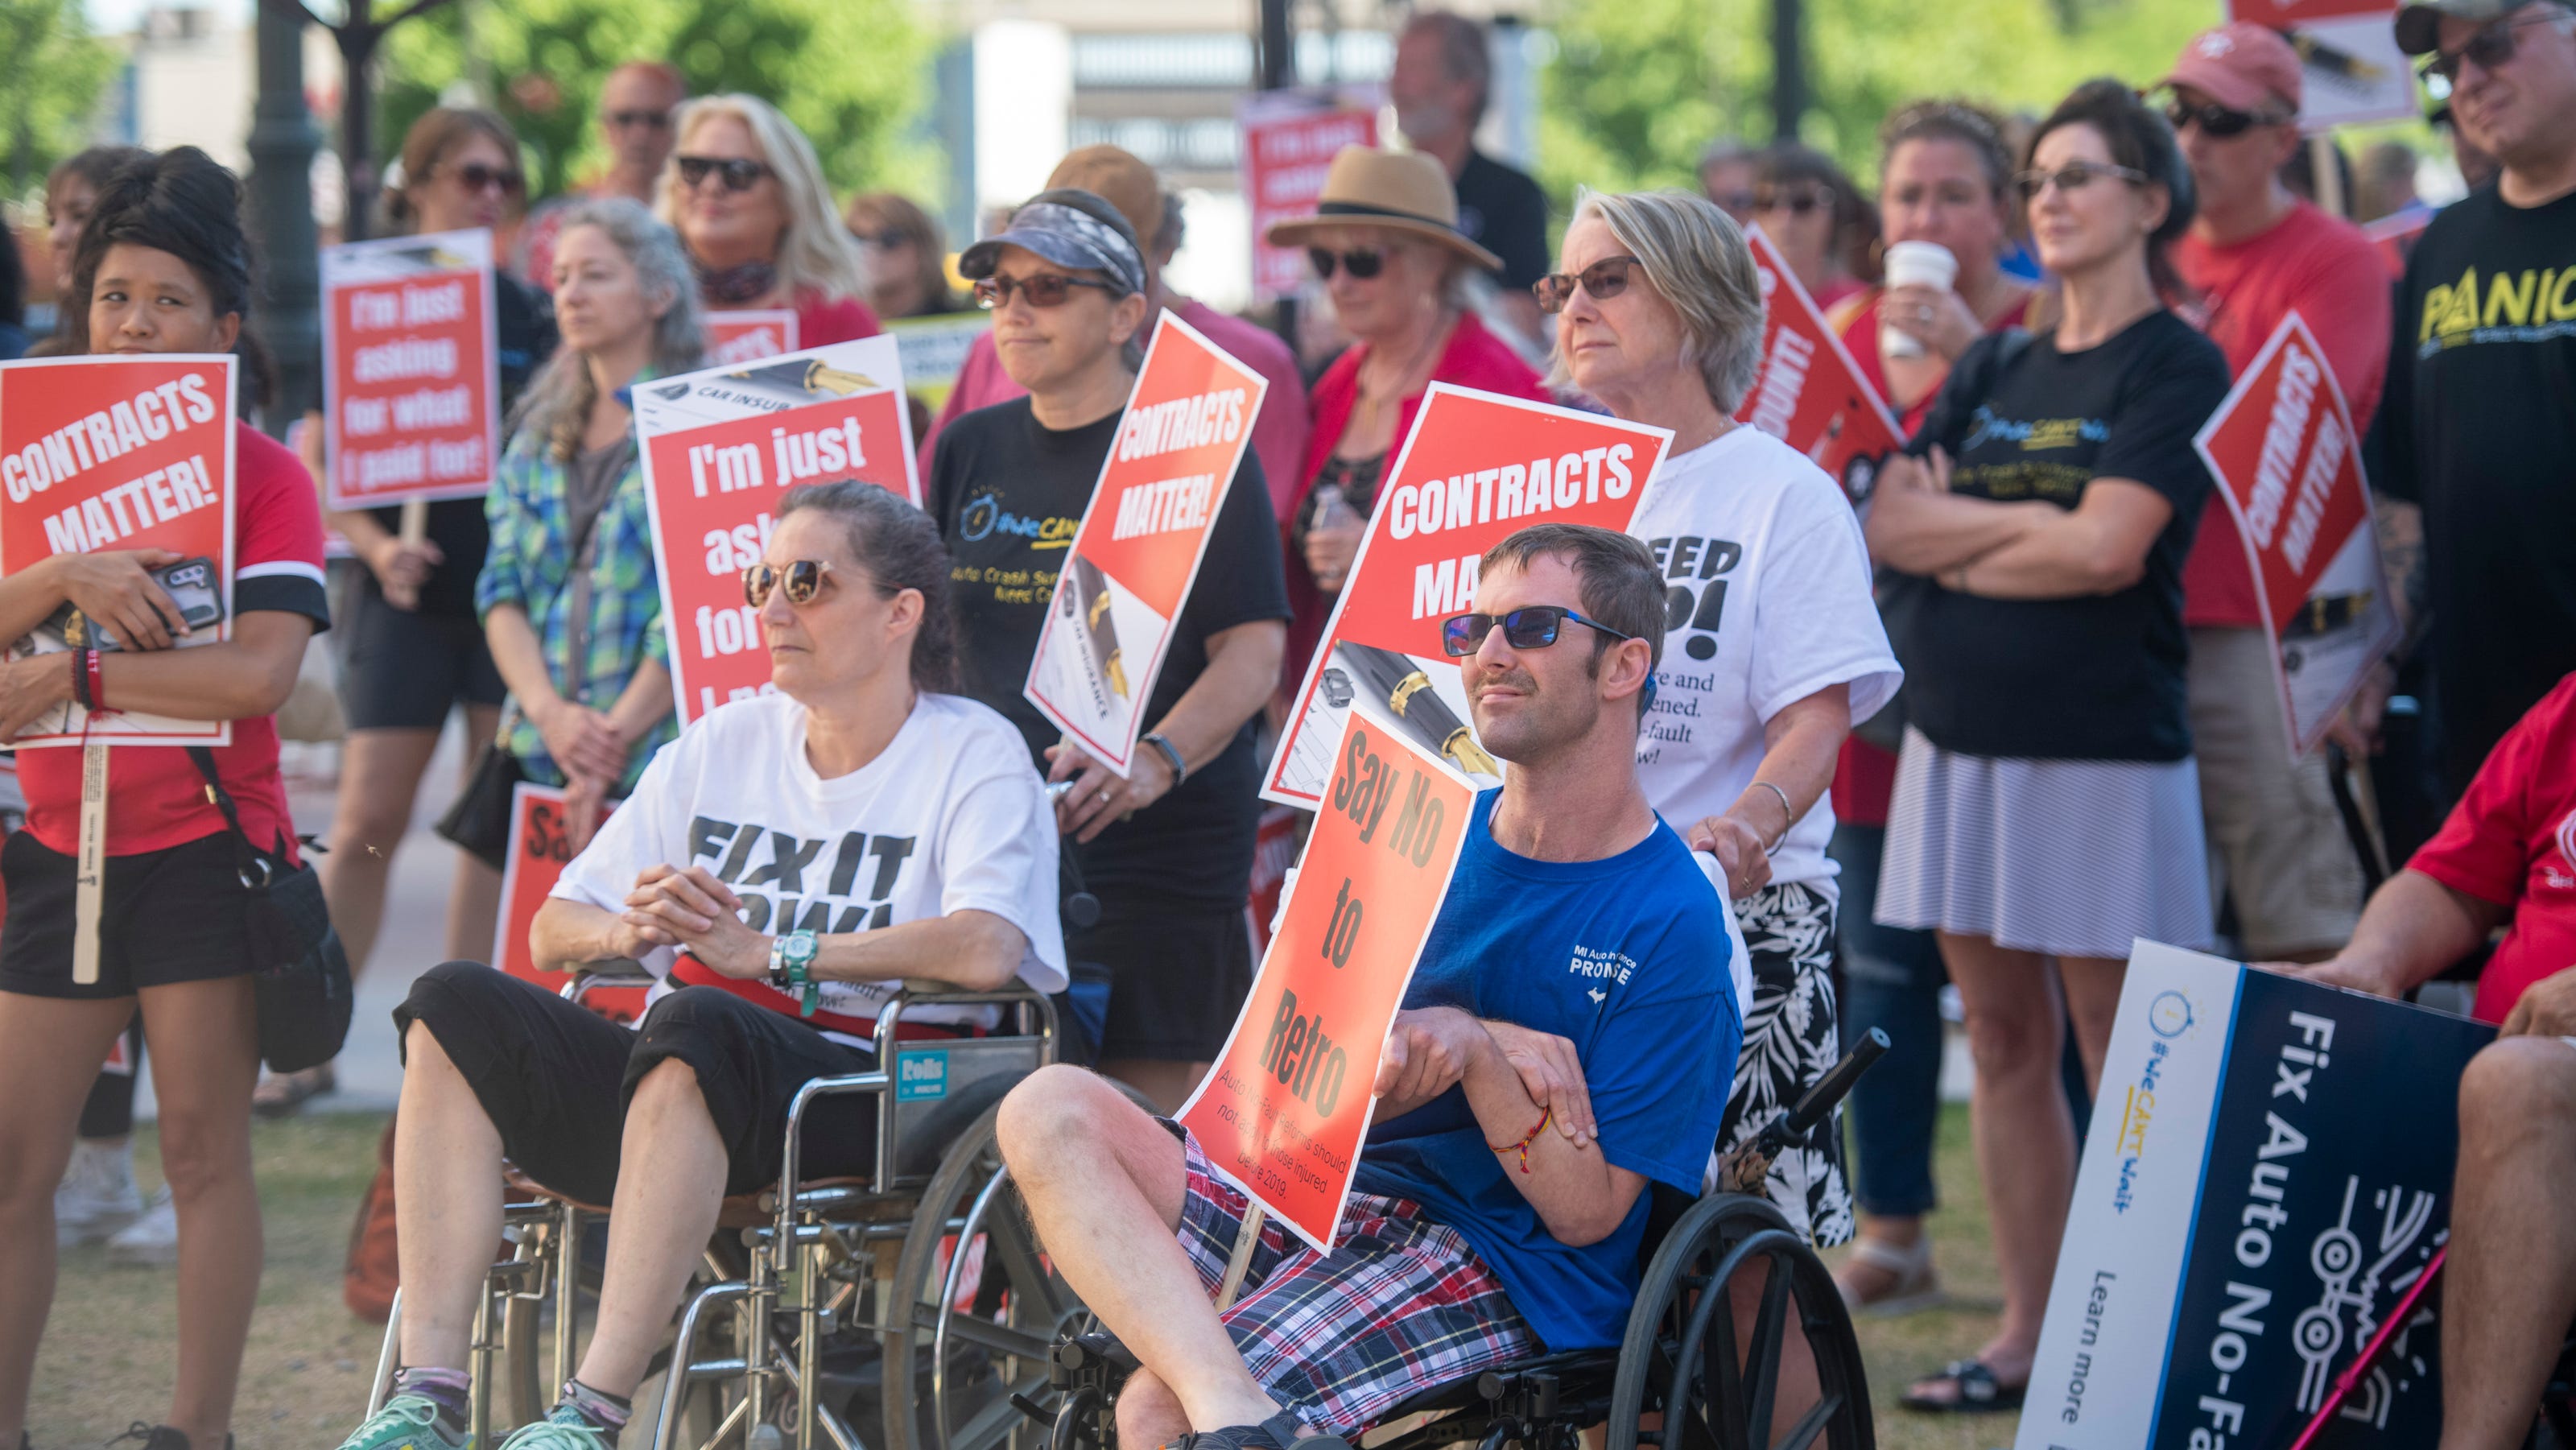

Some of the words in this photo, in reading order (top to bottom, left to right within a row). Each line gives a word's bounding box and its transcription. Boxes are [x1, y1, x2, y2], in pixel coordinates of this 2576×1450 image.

[1, 373, 215, 503] CONTRACTS
[689, 444, 764, 498] I'm
[771, 416, 867, 486] just
[1119, 388, 1245, 462] CONTRACTS
[2248, 342, 2320, 550] CONTRACTS
[43, 454, 219, 555] MATTER!
[1112, 473, 1215, 541] MATTER!
[1390, 443, 1633, 540] CONTRACTS
[696, 605, 761, 659] for
[1651, 698, 1701, 717] ened.
[1675, 673, 1714, 692] and
[1643, 721, 1692, 743] -fault
[528, 805, 571, 862] Sa
[1334, 730, 1400, 844] Say
[1388, 769, 1444, 868] No
[688, 816, 827, 894] FIX
[828, 832, 916, 901] IT
[1321, 877, 1363, 969] to
[1574, 945, 1587, 957] MI
[1258, 987, 1346, 1118] Retro
[2271, 1010, 2335, 1105] Fix
[1217, 1104, 1239, 1125] not
[1294, 1159, 1327, 1193] injured
[1219, 1069, 1246, 1096] Auto
[1279, 1112, 1312, 1151] Reforms
[1313, 1143, 1348, 1174] should
[1236, 1148, 1264, 1180] before
[1263, 1170, 1287, 1199] 2019.
[2234, 1109, 2309, 1269] Auto
[2080, 1270, 2117, 1347] Learn
[2062, 1353, 2091, 1425] more
